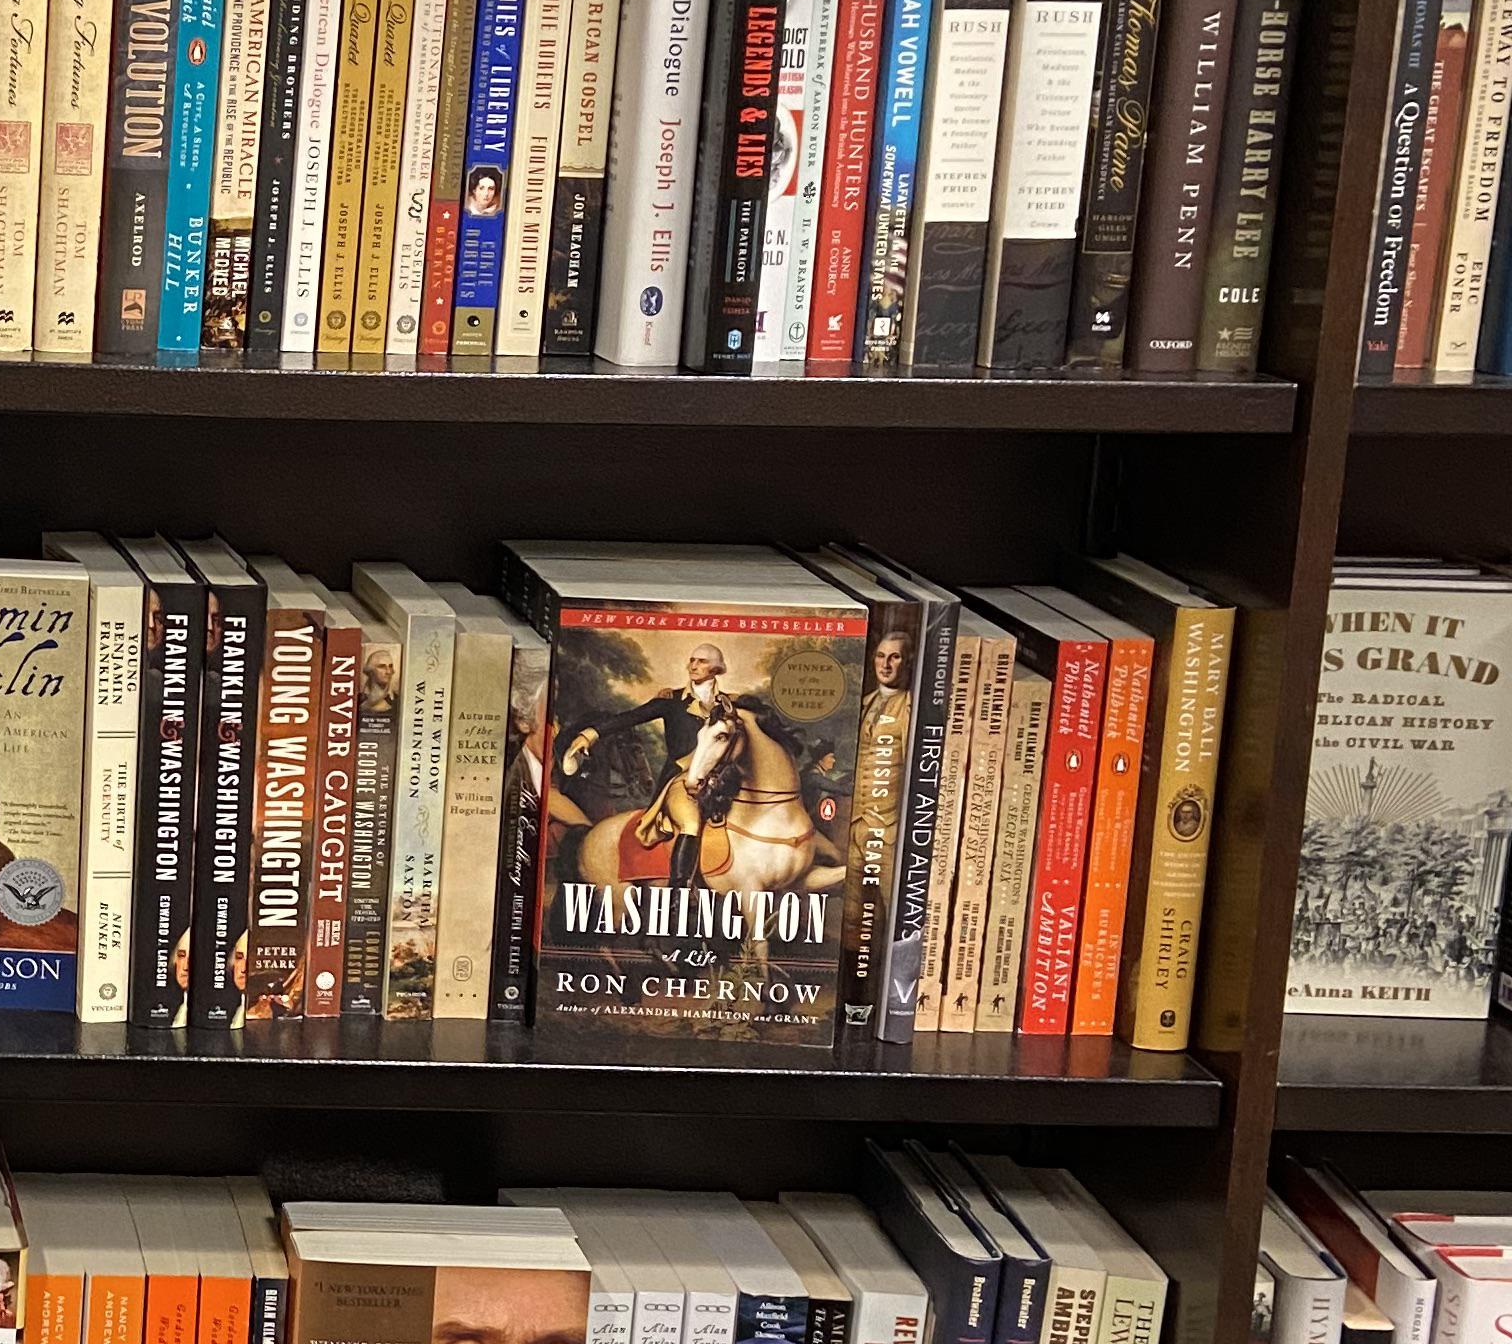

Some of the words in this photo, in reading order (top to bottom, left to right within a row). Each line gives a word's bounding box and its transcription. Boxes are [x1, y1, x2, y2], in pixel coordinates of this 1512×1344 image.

[663, 0, 692, 97] Dialogue
[741, 7, 777, 99] LEGENDS
[891, 36, 918, 127] VOWELL
[486, 66, 512, 153] LIBERTY
[1182, 11, 1222, 165] WILLIAM
[736, 134, 767, 178] LIES
[1175, 184, 1200, 270] PENN
[1219, 287, 1260, 303] COLE
[582, 613, 618, 625] NEW
[626, 615, 669, 627] YORK
[677, 618, 730, 629] TIMES
[739, 620, 846, 631] BESTSELLER
[268, 627, 314, 725] YOUNG
[1356, 648, 1500, 685] GRAND
[326, 656, 355, 757] NEVER
[1346, 736, 1402, 750] CIVIL
[1405, 739, 1455, 751] WAR
[259, 737, 308, 928] WASHINGTON
[318, 770, 348, 903] CAUGHT
[562, 882, 828, 945] WASHINGTON
[256, 946, 296, 956] PETER
[256, 959, 295, 969] STARK
[556, 972, 626, 993] RON
[641, 977, 821, 1004] CHERNOW
[1360, 985, 1432, 1001] KEITH
